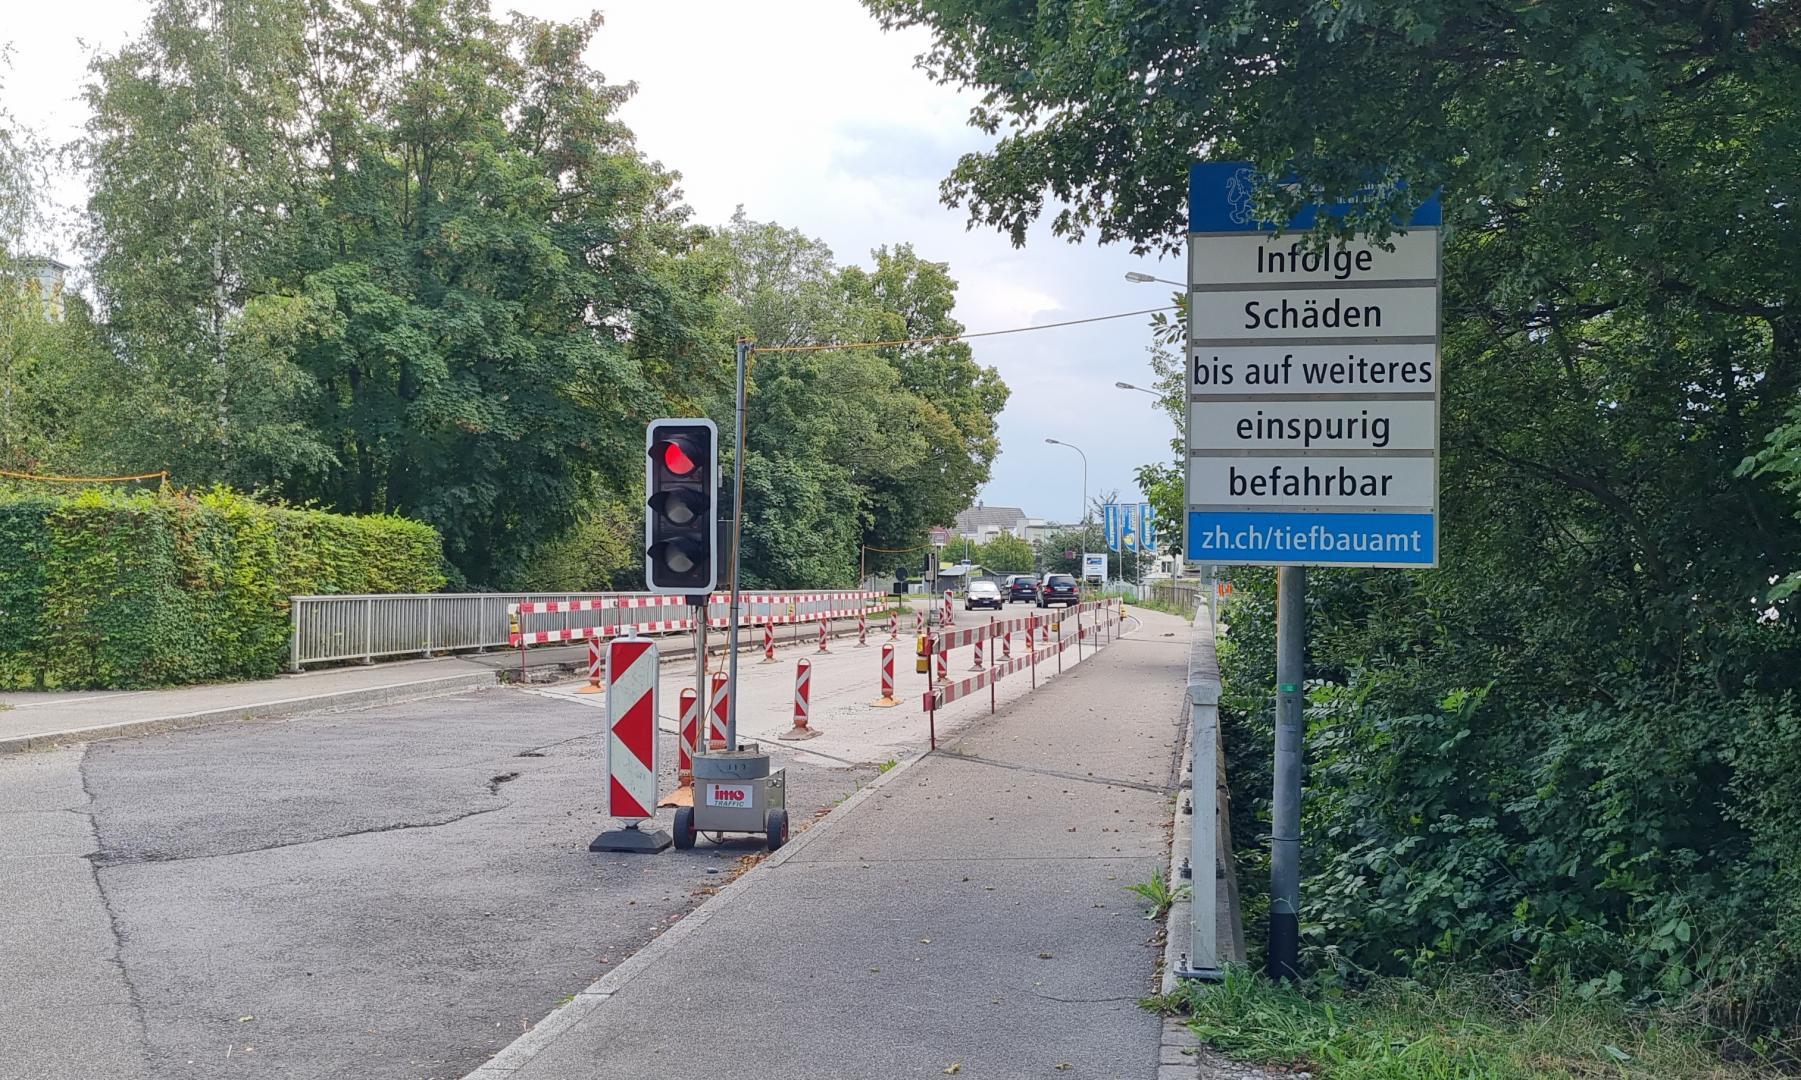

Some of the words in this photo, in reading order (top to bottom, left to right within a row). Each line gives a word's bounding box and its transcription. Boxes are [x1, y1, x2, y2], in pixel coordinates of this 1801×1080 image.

[1258, 244, 1373, 279] Infolge
[1245, 298, 1382, 329] Schäden
[1194, 356, 1234, 385] bis
[1245, 354, 1293, 384] auf
[1303, 354, 1432, 384] weiteres
[1237, 410, 1390, 447] einspurig
[1229, 466, 1393, 496] befahrbar
[1202, 525, 1421, 552] zh.ch/tiefbauamt
[714, 784, 745, 801] imo
[714, 800, 745, 808] TRAFFIC
